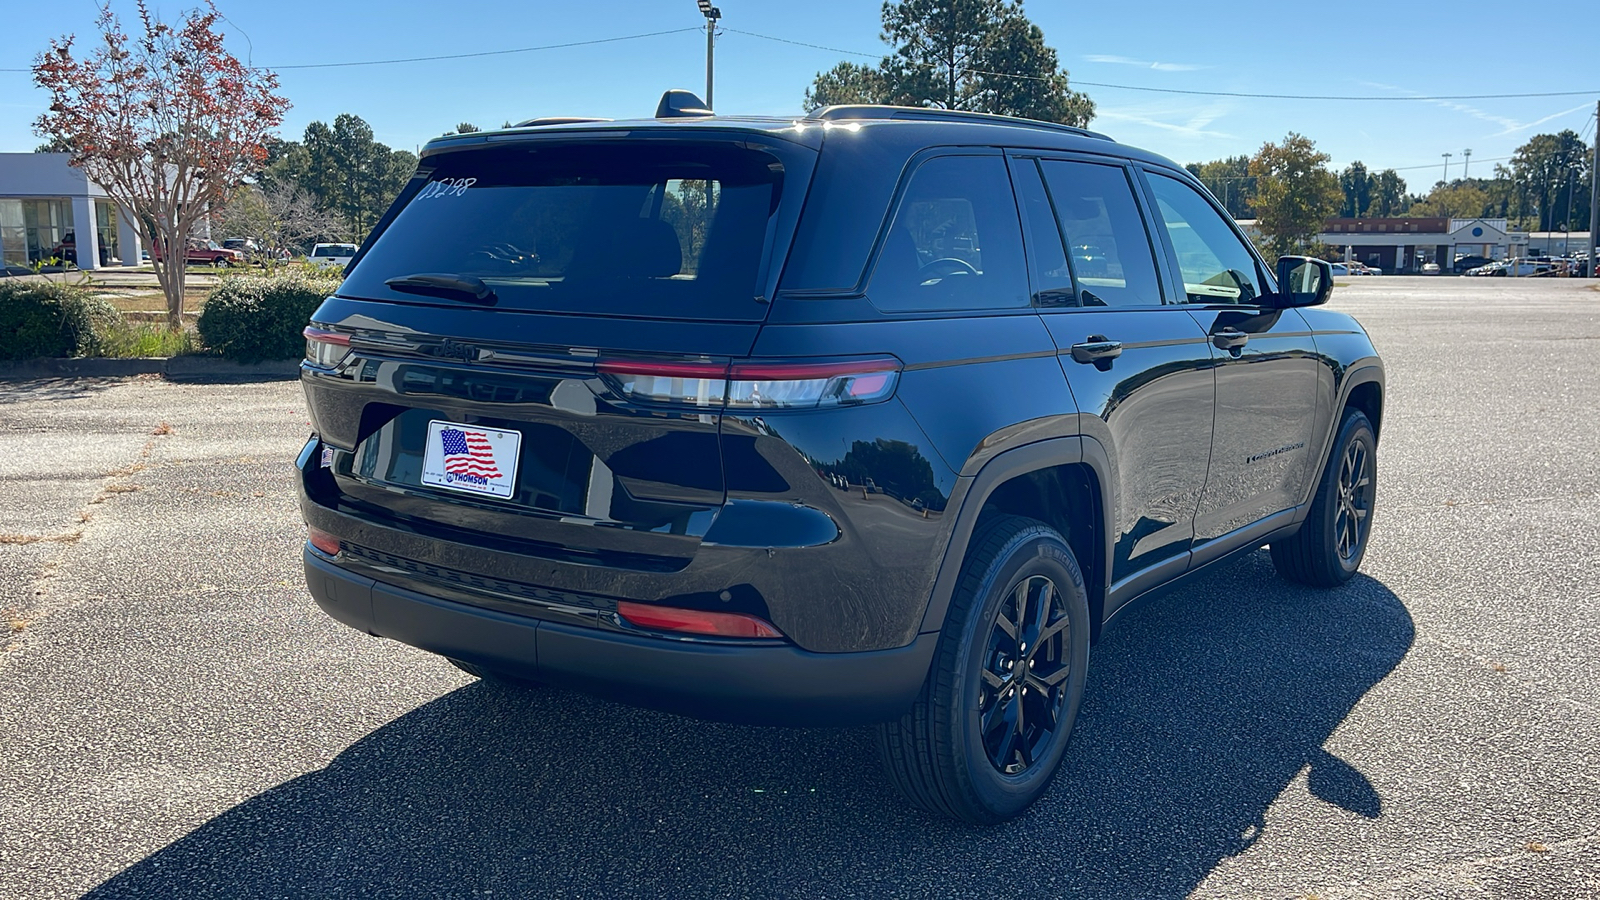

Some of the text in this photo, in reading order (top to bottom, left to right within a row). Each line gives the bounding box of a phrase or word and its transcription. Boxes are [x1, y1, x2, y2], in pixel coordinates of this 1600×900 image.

[433, 338, 475, 364] Jeep
[454, 472, 489, 486] THOMSON
[1053, 548, 1081, 585] MICHELIN
